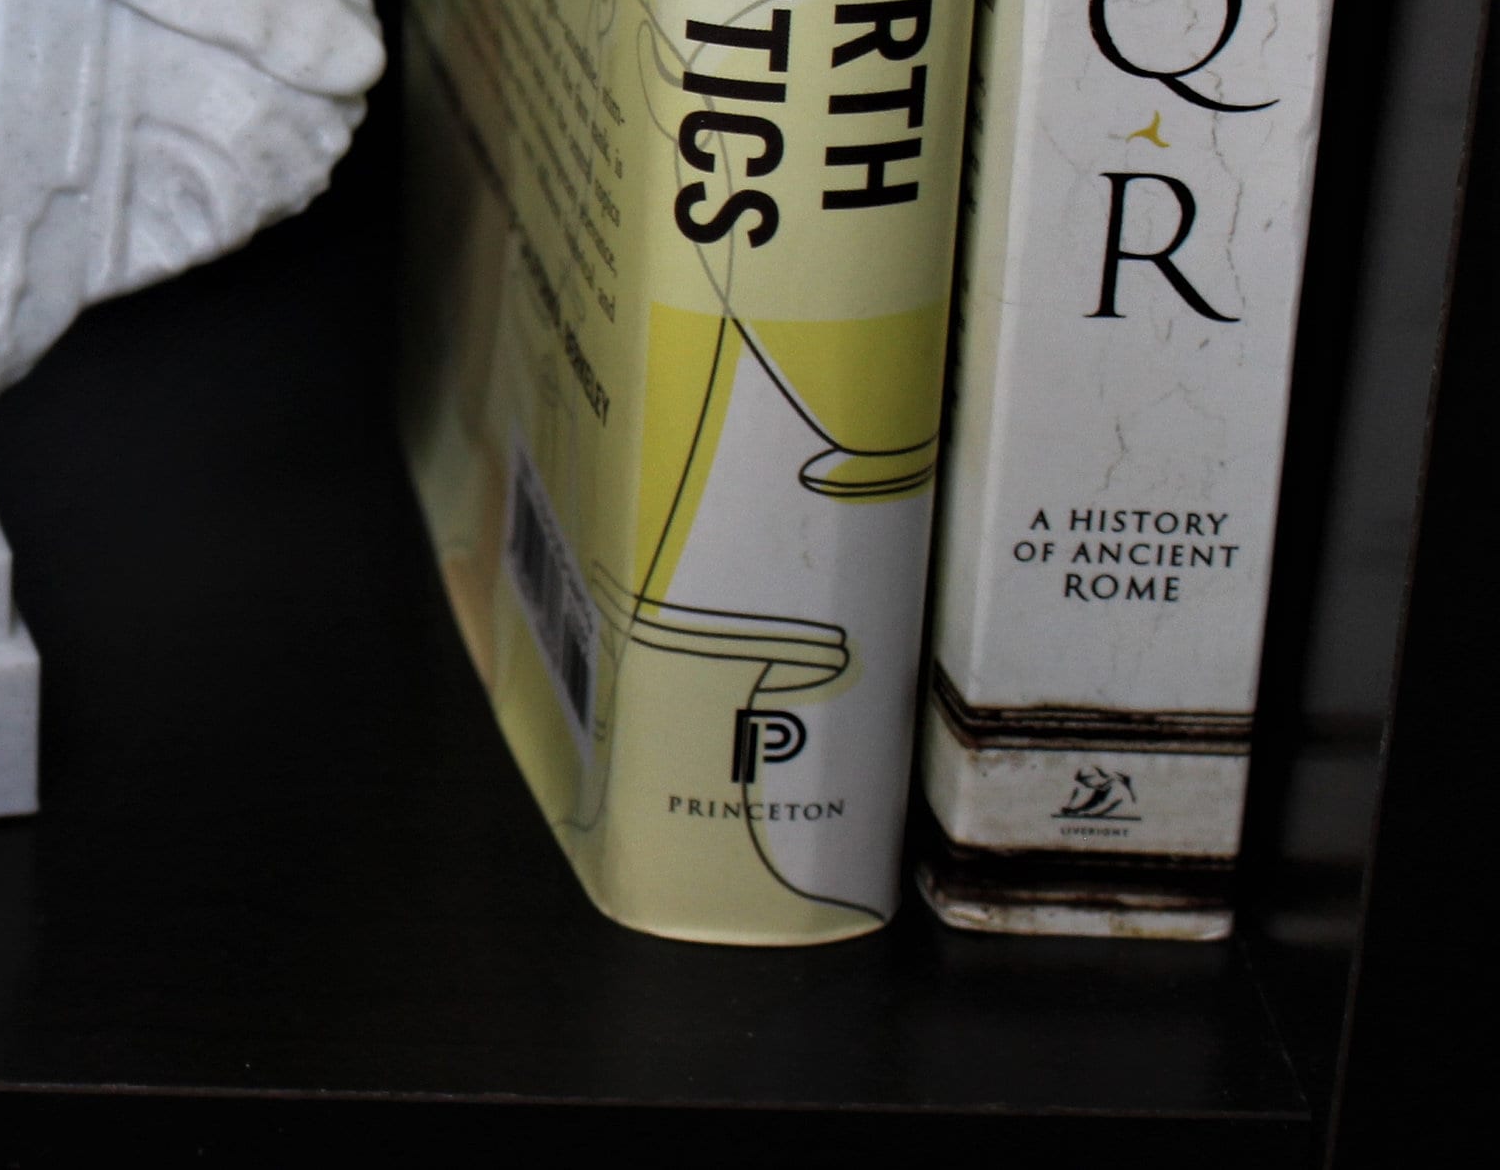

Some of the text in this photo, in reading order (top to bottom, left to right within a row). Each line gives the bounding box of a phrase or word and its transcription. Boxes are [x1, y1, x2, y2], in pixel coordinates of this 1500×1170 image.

[1030, 509, 1229, 535] A HISTORY
[1013, 541, 1240, 568] OF ANCIENT
[1063, 574, 1181, 602] ROME
[668, 795, 845, 822] PRINCETON
